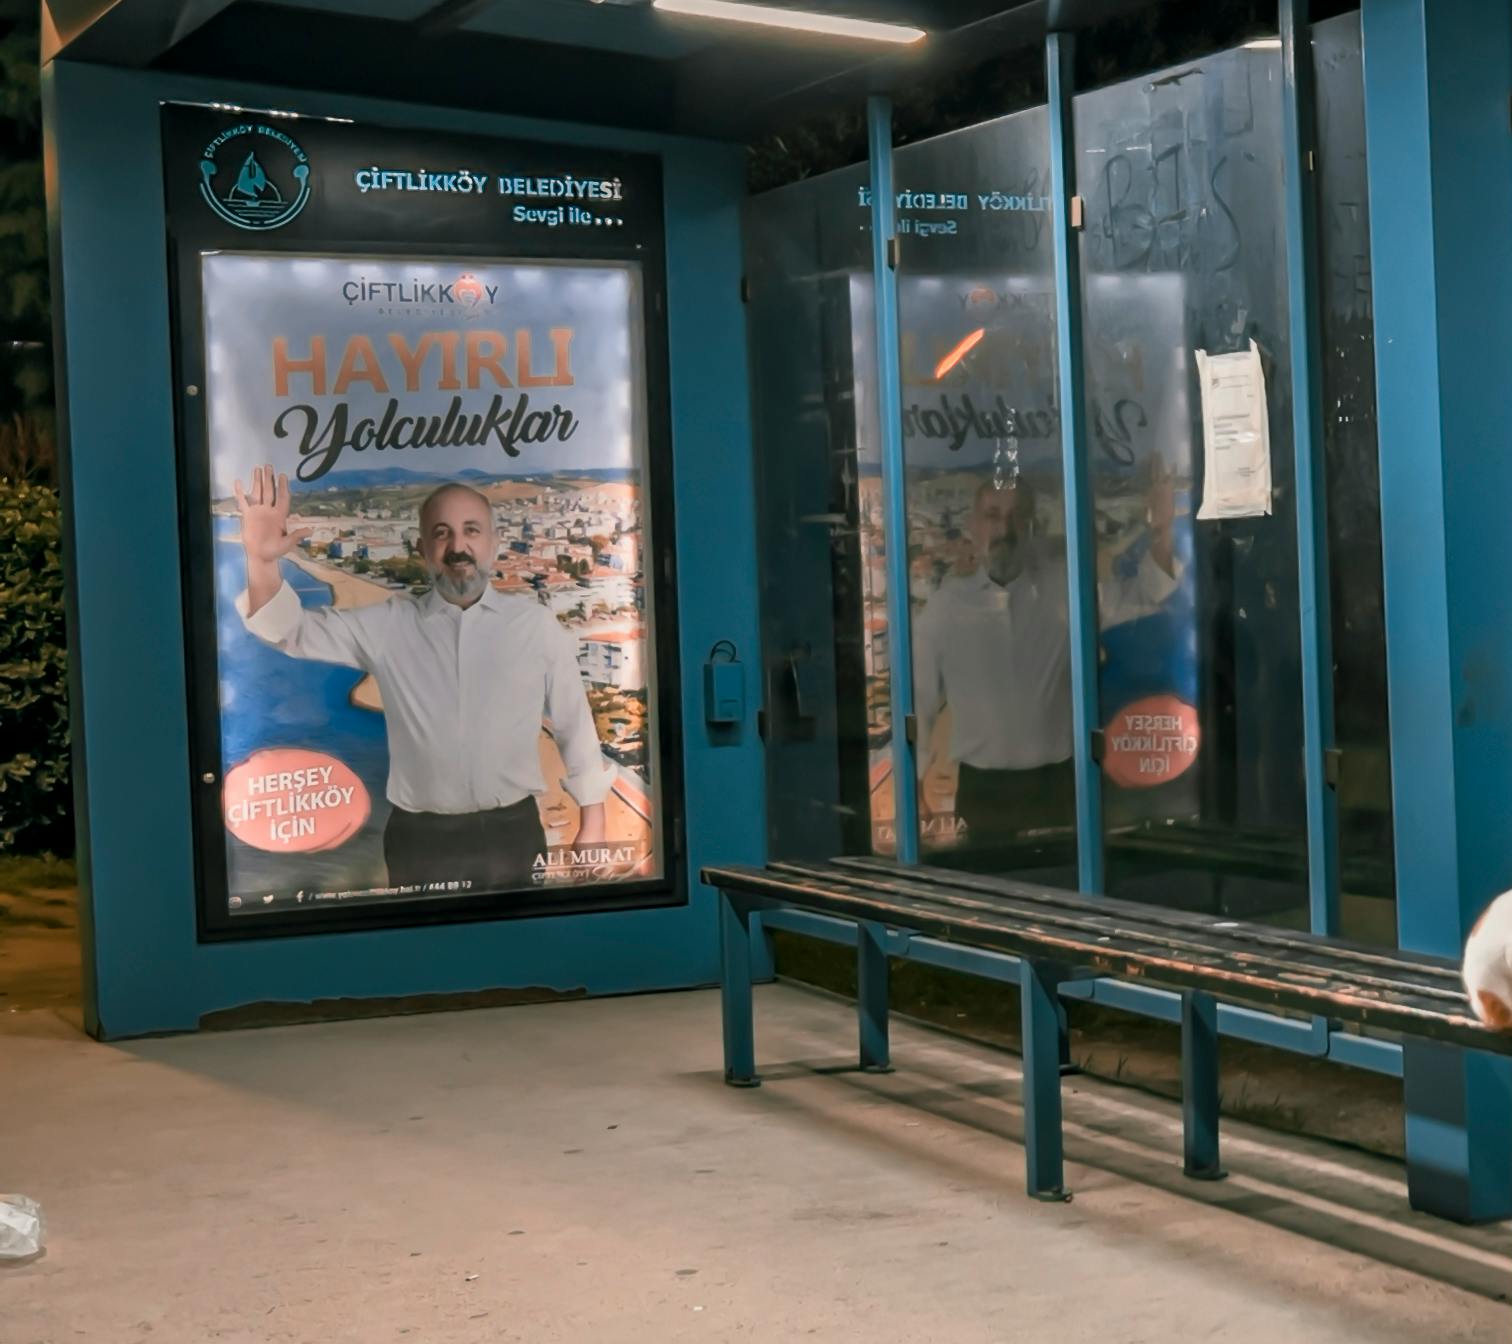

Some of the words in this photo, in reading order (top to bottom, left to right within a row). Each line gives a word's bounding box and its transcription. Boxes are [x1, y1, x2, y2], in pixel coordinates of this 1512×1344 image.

[355, 167, 488, 194] ÇİFTLİKKÖY
[499, 175, 622, 200] BELEDİYESİ
[513, 205, 564, 226] Sevgi
[272, 326, 576, 397] HAYIRLI
[273, 392, 579, 483] Yolculuklar
[247, 765, 333, 793] HERŞEY
[227, 784, 354, 828] ÇİFTLİKKÖY
[271, 815, 316, 844] İÇİN
[532, 848, 566, 867] ALİ
[570, 846, 636, 865] MURAT
